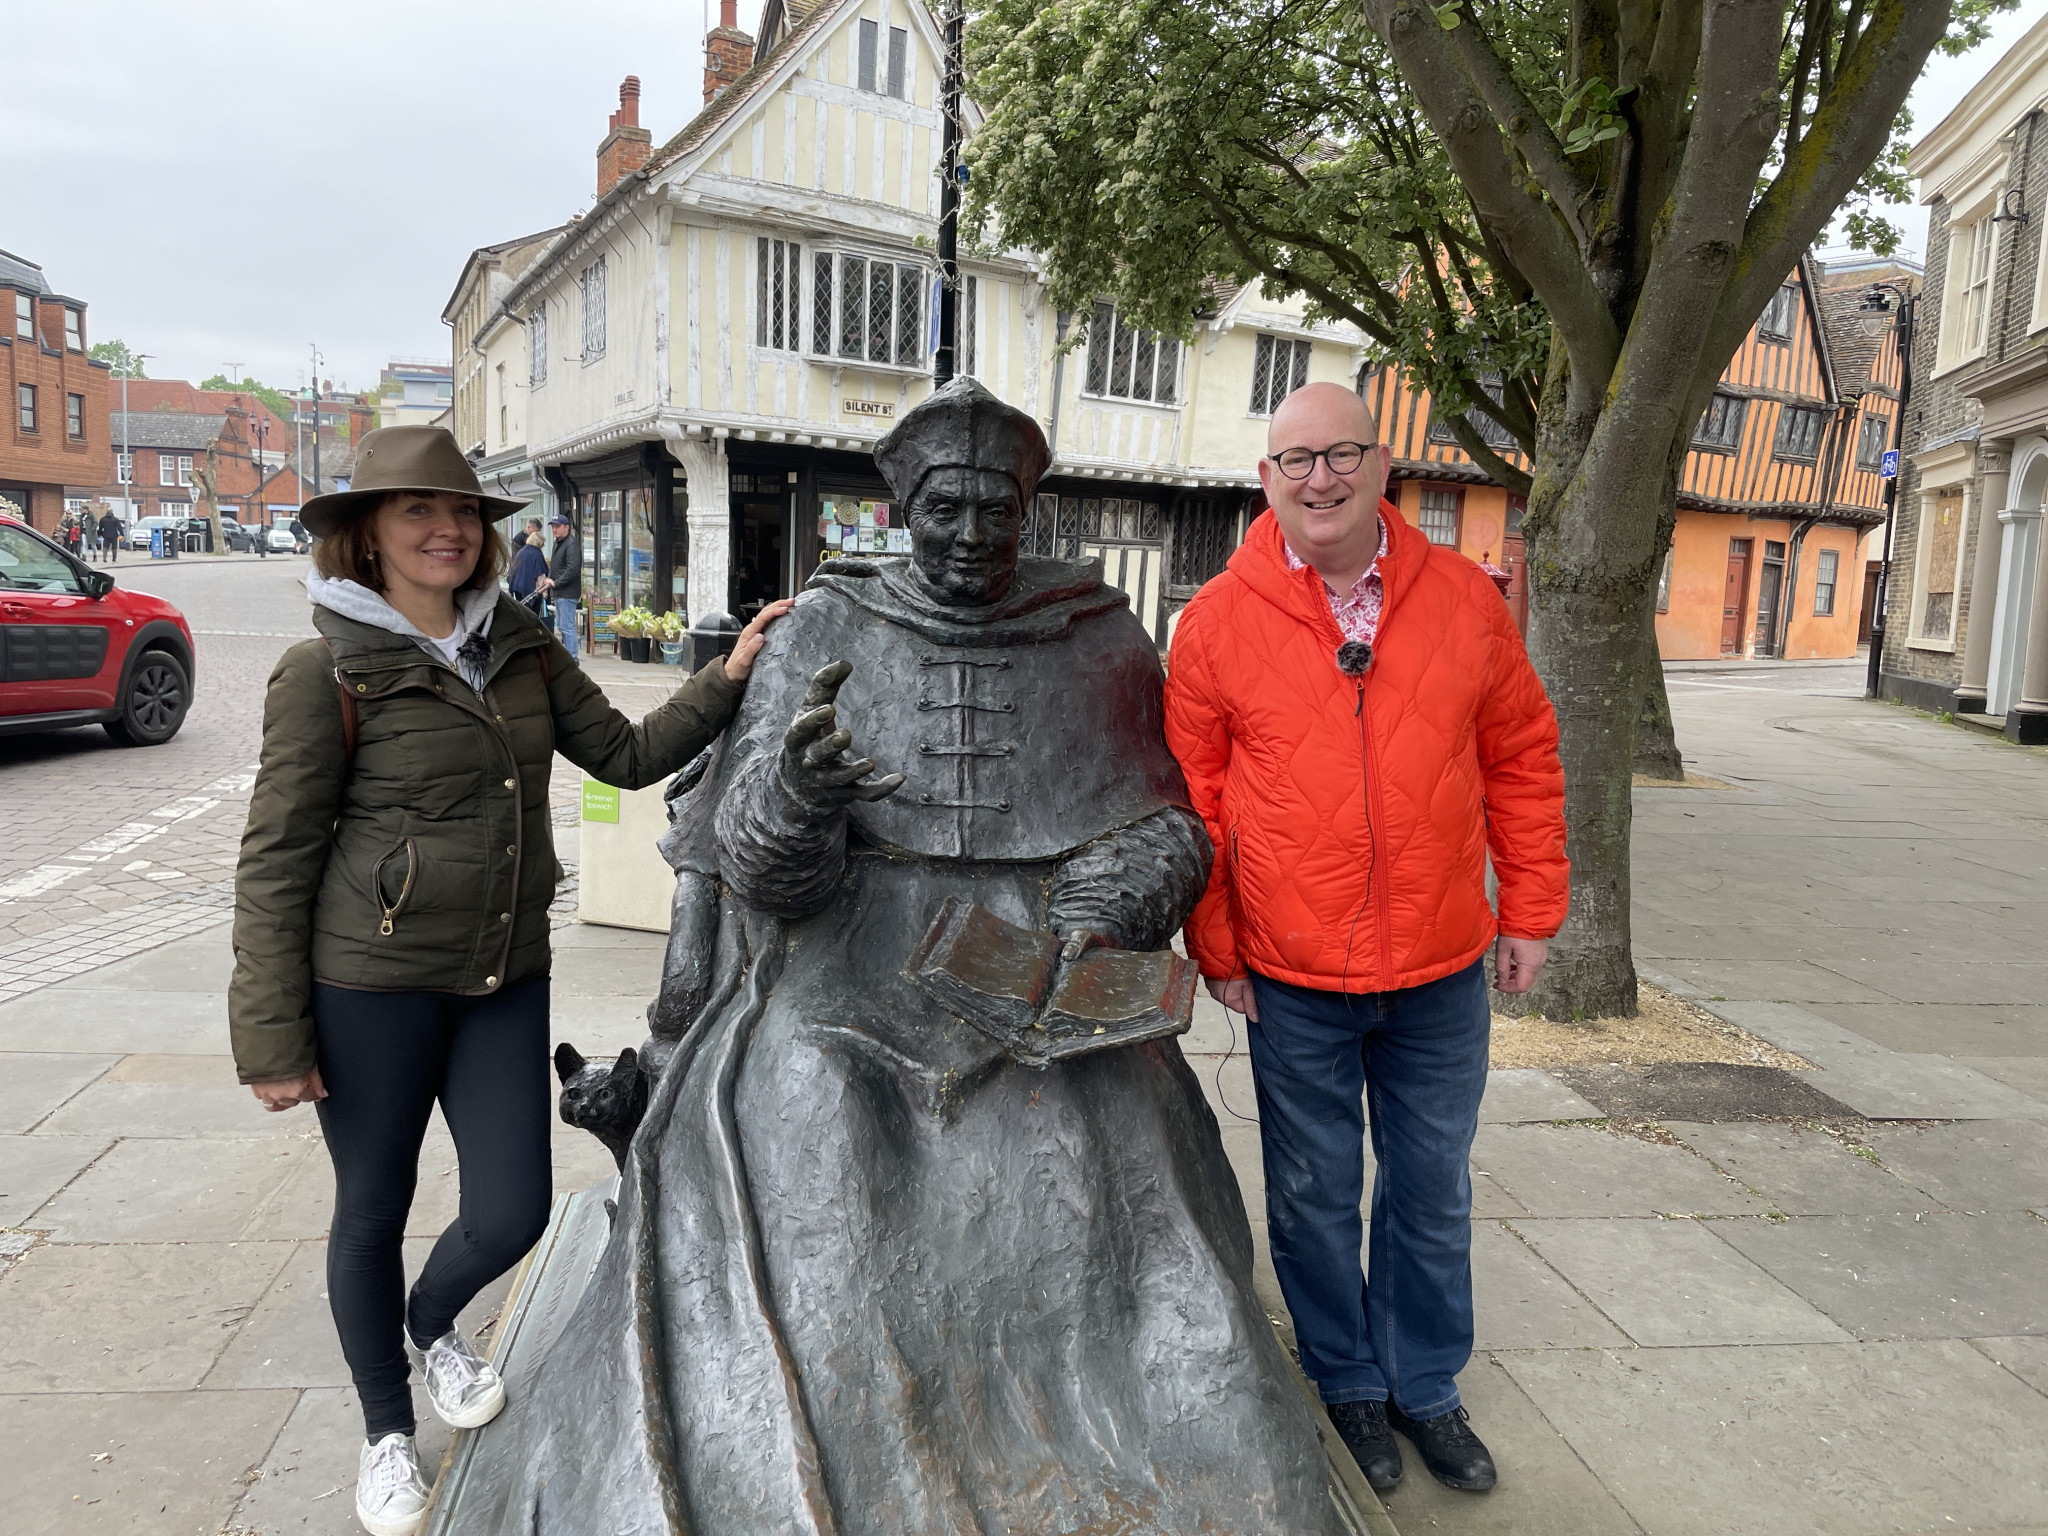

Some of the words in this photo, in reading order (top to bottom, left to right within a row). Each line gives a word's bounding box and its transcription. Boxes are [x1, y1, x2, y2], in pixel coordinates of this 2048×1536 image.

[845, 401, 880, 414] SILENT
[585, 793, 614, 801] Greener
[587, 801, 613, 809] Ipswich
